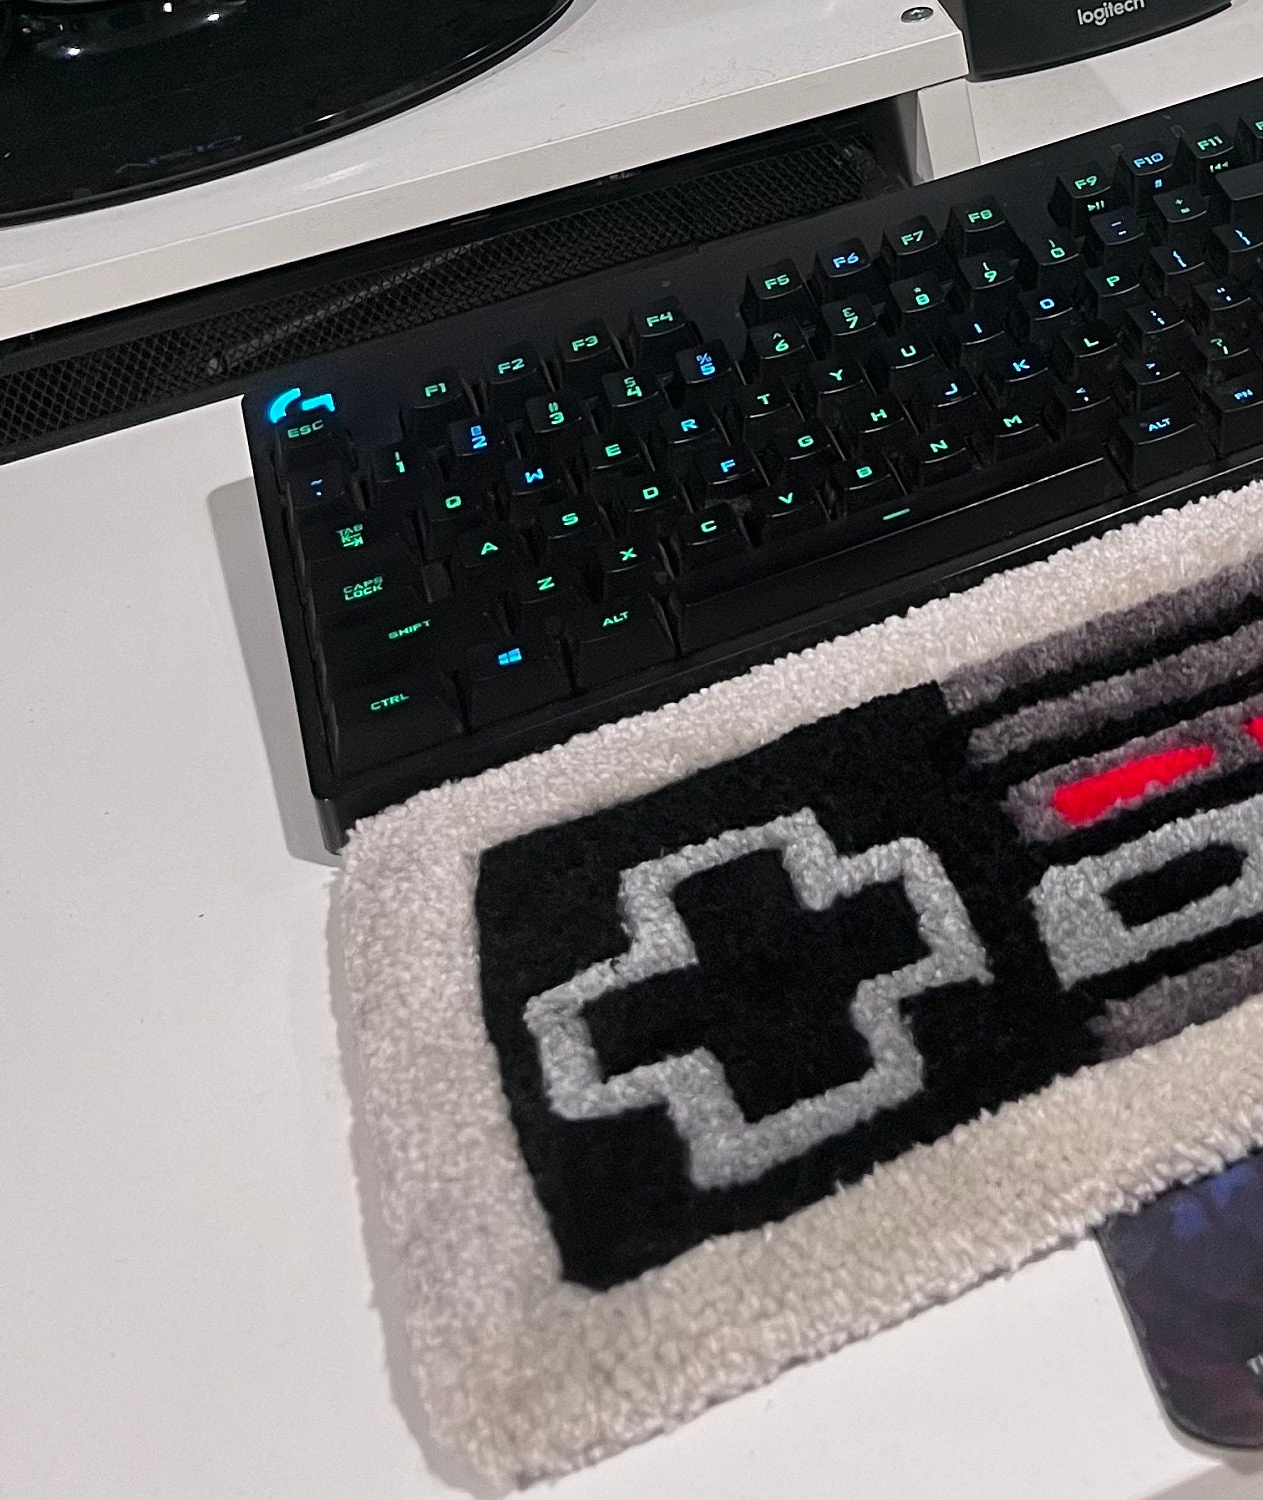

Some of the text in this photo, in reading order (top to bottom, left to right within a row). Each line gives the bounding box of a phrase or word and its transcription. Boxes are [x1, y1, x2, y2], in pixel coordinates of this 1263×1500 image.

[1197, 135, 1223, 151] F11
[1133, 152, 1164, 168] F10
[1074, 175, 1098, 190] F9
[900, 230, 924, 246] F7
[832, 252, 859, 269] F6
[764, 274, 790, 290] F5
[983, 267, 998, 283] 9
[1106, 275, 1120, 287] P
[1039, 298, 1055, 310] O
[646, 311, 674, 328] F4
[843, 313, 859, 329] 7
[571, 335, 599, 352] F3
[775, 338, 790, 352] 6
[1083, 337, 1100, 348] L
[900, 345, 917, 358] U
[497, 358, 525, 375] F2
[699, 361, 716, 376] 5
[1012, 358, 1031, 372] K
[828, 368, 843, 381] Y
[424, 382, 447, 398] F1
[626, 382, 643, 397] 4
[944, 382, 959, 396] J
[756, 393, 770, 405] T
[549, 411, 565, 425] 3
[870, 408, 888, 422] H
[1002, 414, 1023, 428] M
[287, 419, 324, 439] ESC
[680, 418, 698, 432] R
[1148, 417, 1171, 432] ALT
[471, 434, 488, 450] 2
[797, 435, 814, 448] G
[929, 439, 949, 453] N
[604, 443, 622, 457] E
[395, 460, 406, 473] 1
[720, 458, 736, 473] F
[524, 467, 544, 484] W
[642, 486, 659, 500] D
[778, 492, 794, 504] V
[561, 512, 579, 526] S
[700, 520, 717, 533] C
[336, 523, 364, 538] TAB
[480, 541, 499, 556] A
[619, 547, 638, 562] X
[343, 576, 383, 594] CAPS
[536, 576, 555, 591] Z
[343, 583, 383, 601] LOCK
[602, 611, 629, 627] ALT
[388, 620, 430, 639] SHIFT
[370, 693, 409, 711] CTRL
